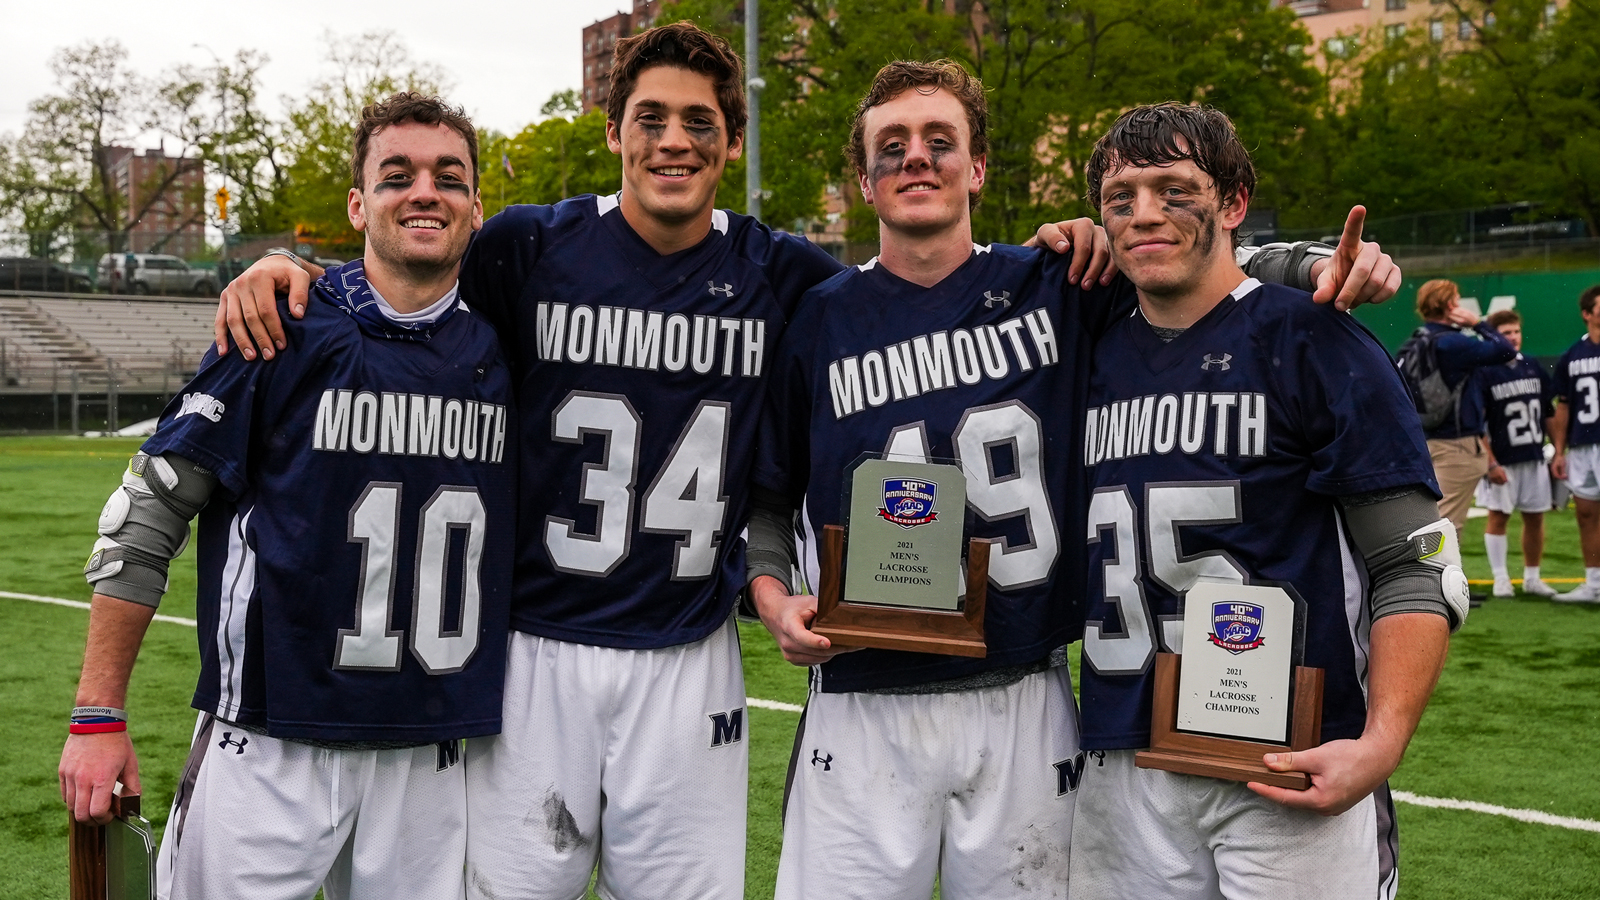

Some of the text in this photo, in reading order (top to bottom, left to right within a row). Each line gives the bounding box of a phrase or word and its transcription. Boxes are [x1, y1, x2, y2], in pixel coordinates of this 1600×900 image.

[536, 301, 767, 378] MONMOUTH
[828, 307, 1060, 420] MONMOUTH
[1575, 376, 1600, 424] 3
[312, 388, 506, 464] MONMOUTH
[1504, 398, 1543, 447] 20
[1084, 392, 1267, 468] MONMOUTH
[543, 390, 731, 582] 34
[901, 481, 926, 492] 40TH
[885, 490, 933, 502] ANNIVERSARY
[894, 501, 924, 516] MAAC
[897, 541, 914, 549] 2021
[890, 552, 920, 561] MEN'S
[879, 563, 929, 574] LACROSSE
[332, 481, 488, 675] 10
[874, 574, 932, 586] CHAMPIONS
[1082, 479, 1250, 677] 35
[1230, 604, 1253, 615] 40TH
[1215, 614, 1260, 626] ANNIVERSARY
[1223, 625, 1251, 640] MAAC
[1226, 667, 1242, 676] 2021
[1219, 678, 1248, 689] MEN'S
[1209, 690, 1257, 702] LACROSSE
[1204, 702, 1260, 716] CHAMPIONS
[709, 707, 743, 748] M
